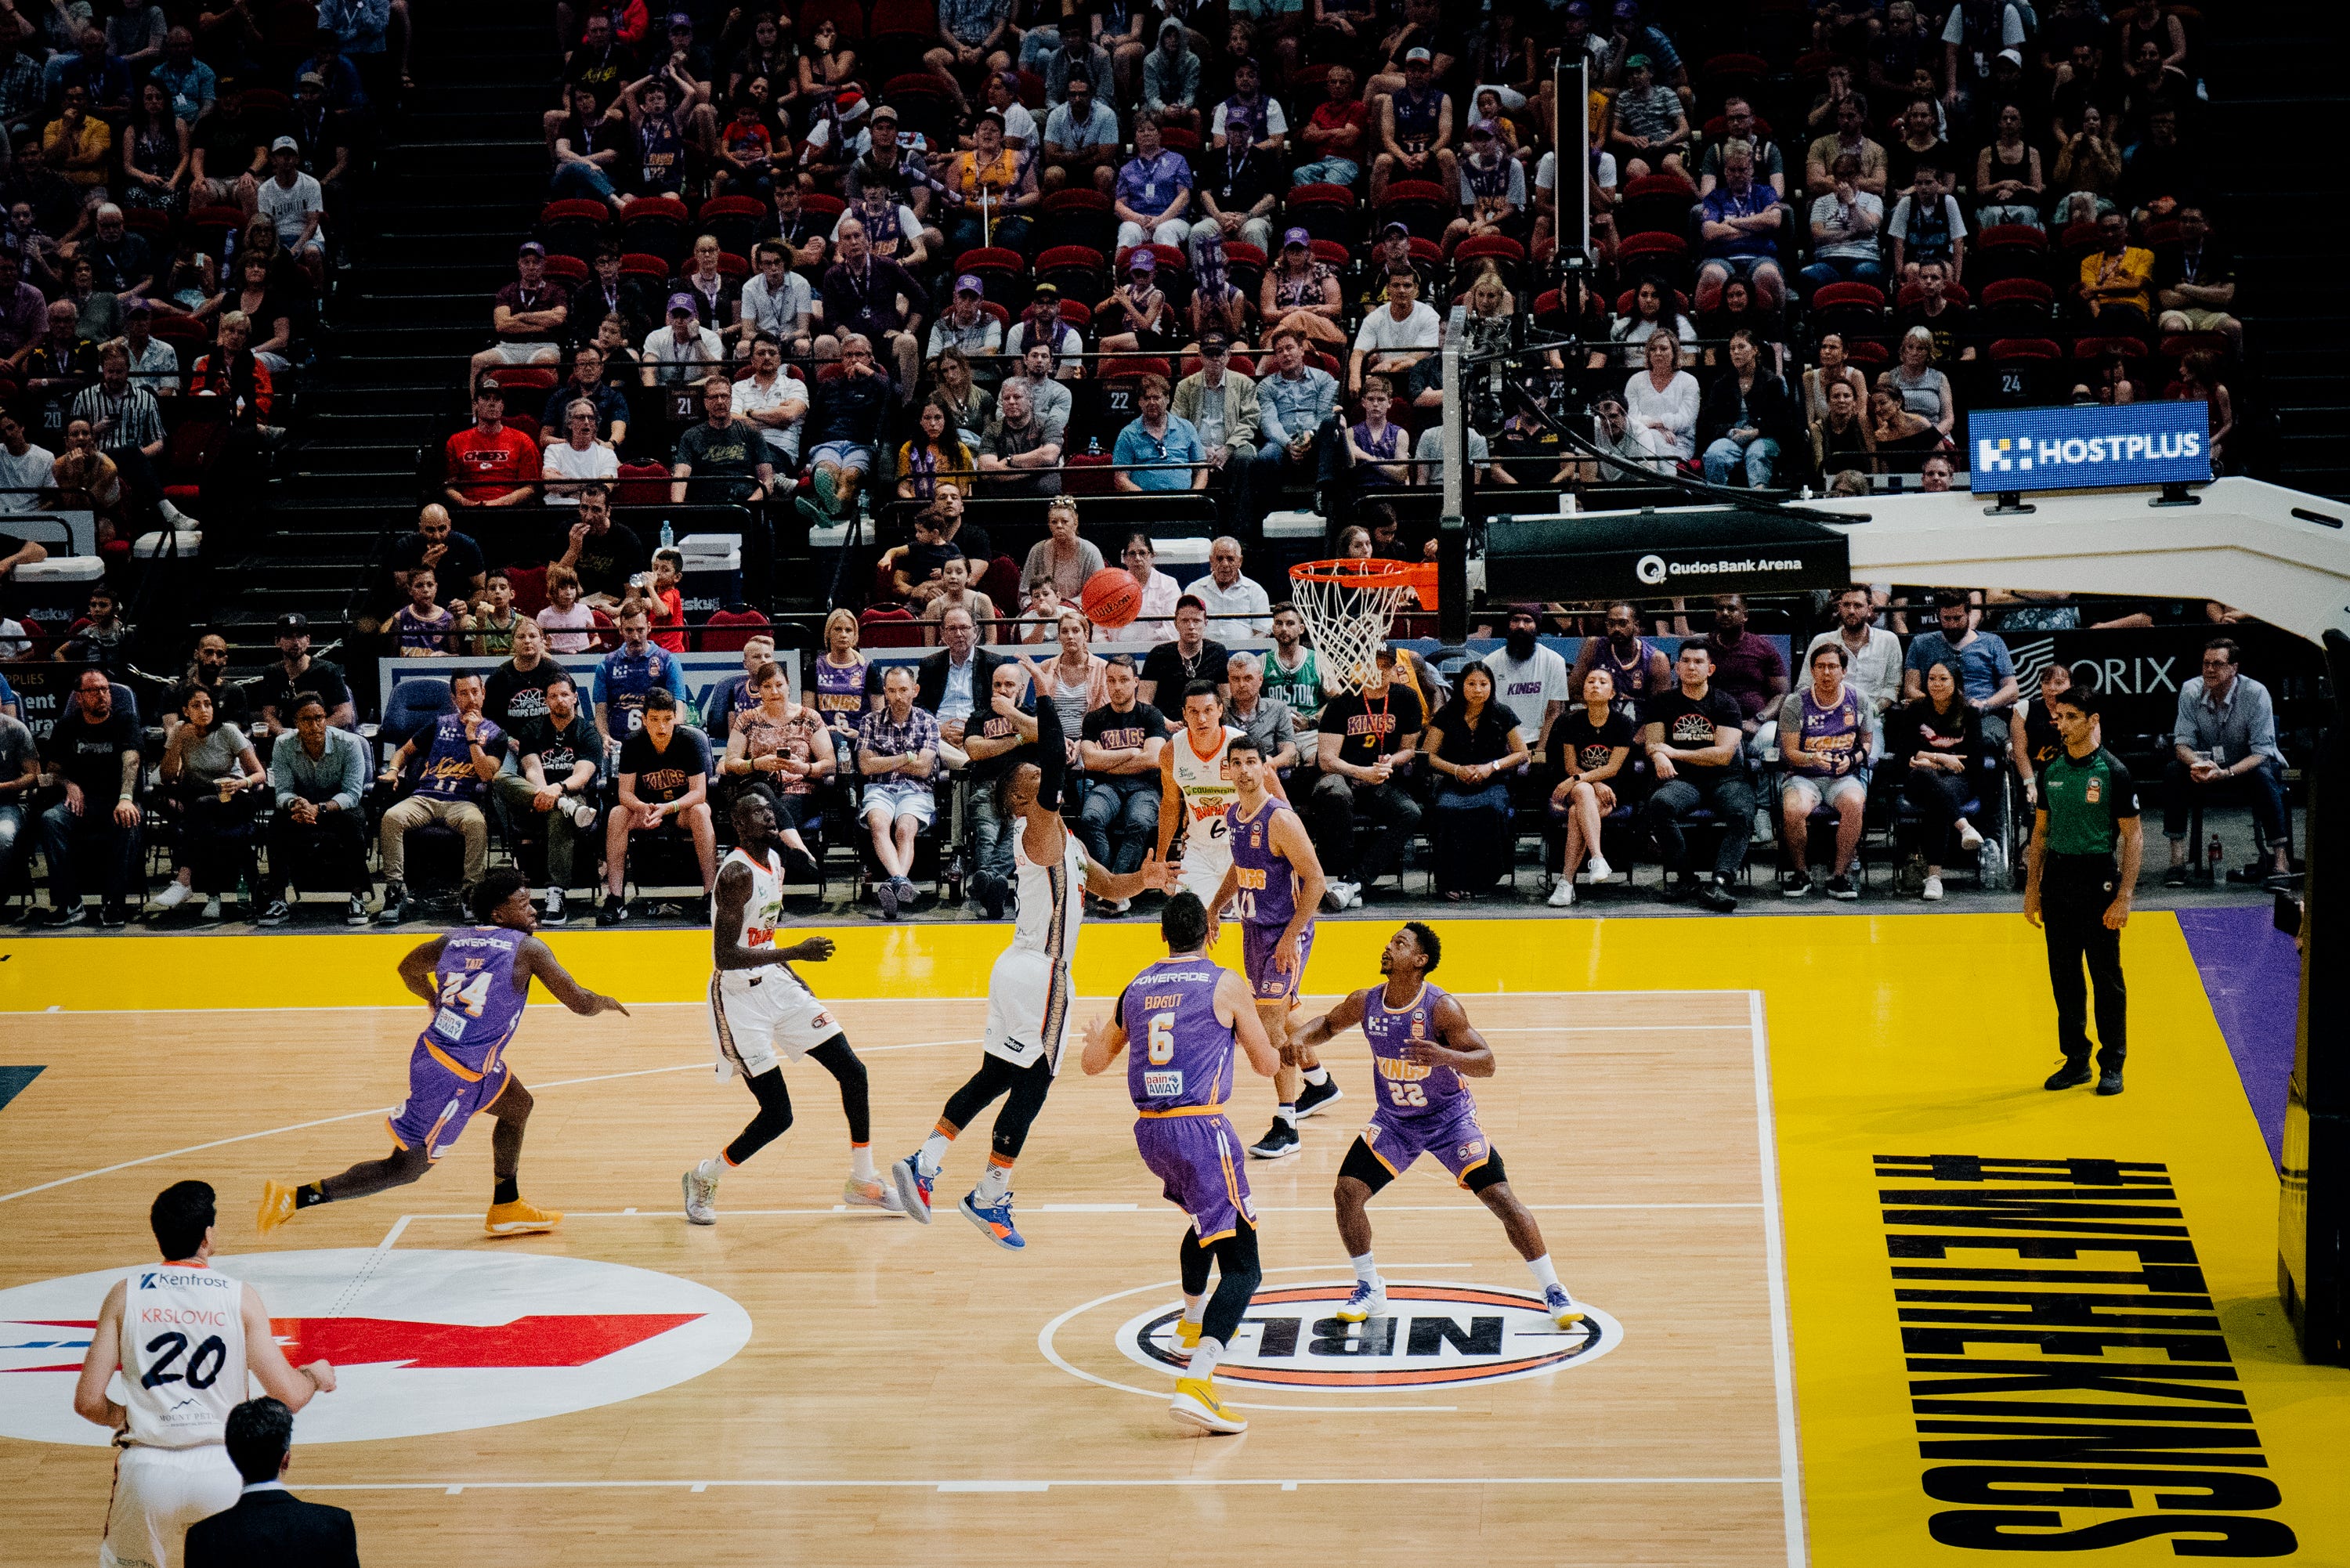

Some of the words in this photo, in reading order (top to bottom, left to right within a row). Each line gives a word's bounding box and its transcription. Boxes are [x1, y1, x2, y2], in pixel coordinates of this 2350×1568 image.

[2002, 374, 2022, 392] 24
[678, 397, 692, 414] 21
[1111, 392, 1130, 410] 22
[44, 412, 63, 428] 20
[463, 450, 510, 461] CHIEFS
[2039, 432, 2200, 465] HOSTPLUS
[1668, 562, 1719, 575] Qudos
[1719, 559, 1755, 573] Bank
[1757, 559, 1803, 572] Arena
[1094, 593, 1132, 618] Wilson
[2069, 656, 2178, 695] ORIX
[1267, 684, 1315, 705] BOSTON
[1507, 681, 1542, 695] KINGS
[818, 694, 862, 712] KINGS
[508, 708, 529, 717] HOOPS
[627, 709, 643, 731] 6
[834, 712, 849, 730] 6
[984, 716, 1020, 739] KIN
[1347, 714, 1396, 736] KINGS
[1100, 727, 1145, 750] KINGS
[642, 768, 689, 791] KINGS
[1210, 819, 1227, 840] 6
[465, 958, 485, 970] TATE
[1132, 972, 1210, 987] POWERADE
[441, 971, 494, 1017] 24
[1144, 993, 1184, 1010] BOGUT
[437, 1020, 460, 1038] AWAY
[1148, 1012, 1176, 1066] 6
[1146, 1074, 1167, 1086] pain
[1149, 1083, 1180, 1094] AWAY
[1387, 1081, 1429, 1107] 22
[160, 1273, 229, 1289] Kenfrost
[142, 1308, 226, 1327] KRSLOVIC
[1238, 1316, 1504, 1357] NBL
[141, 1331, 226, 1390] 20
[1871, 1154, 2299, 1558] #WETHEKINGS
[159, 1413, 191, 1422] MOUNT
